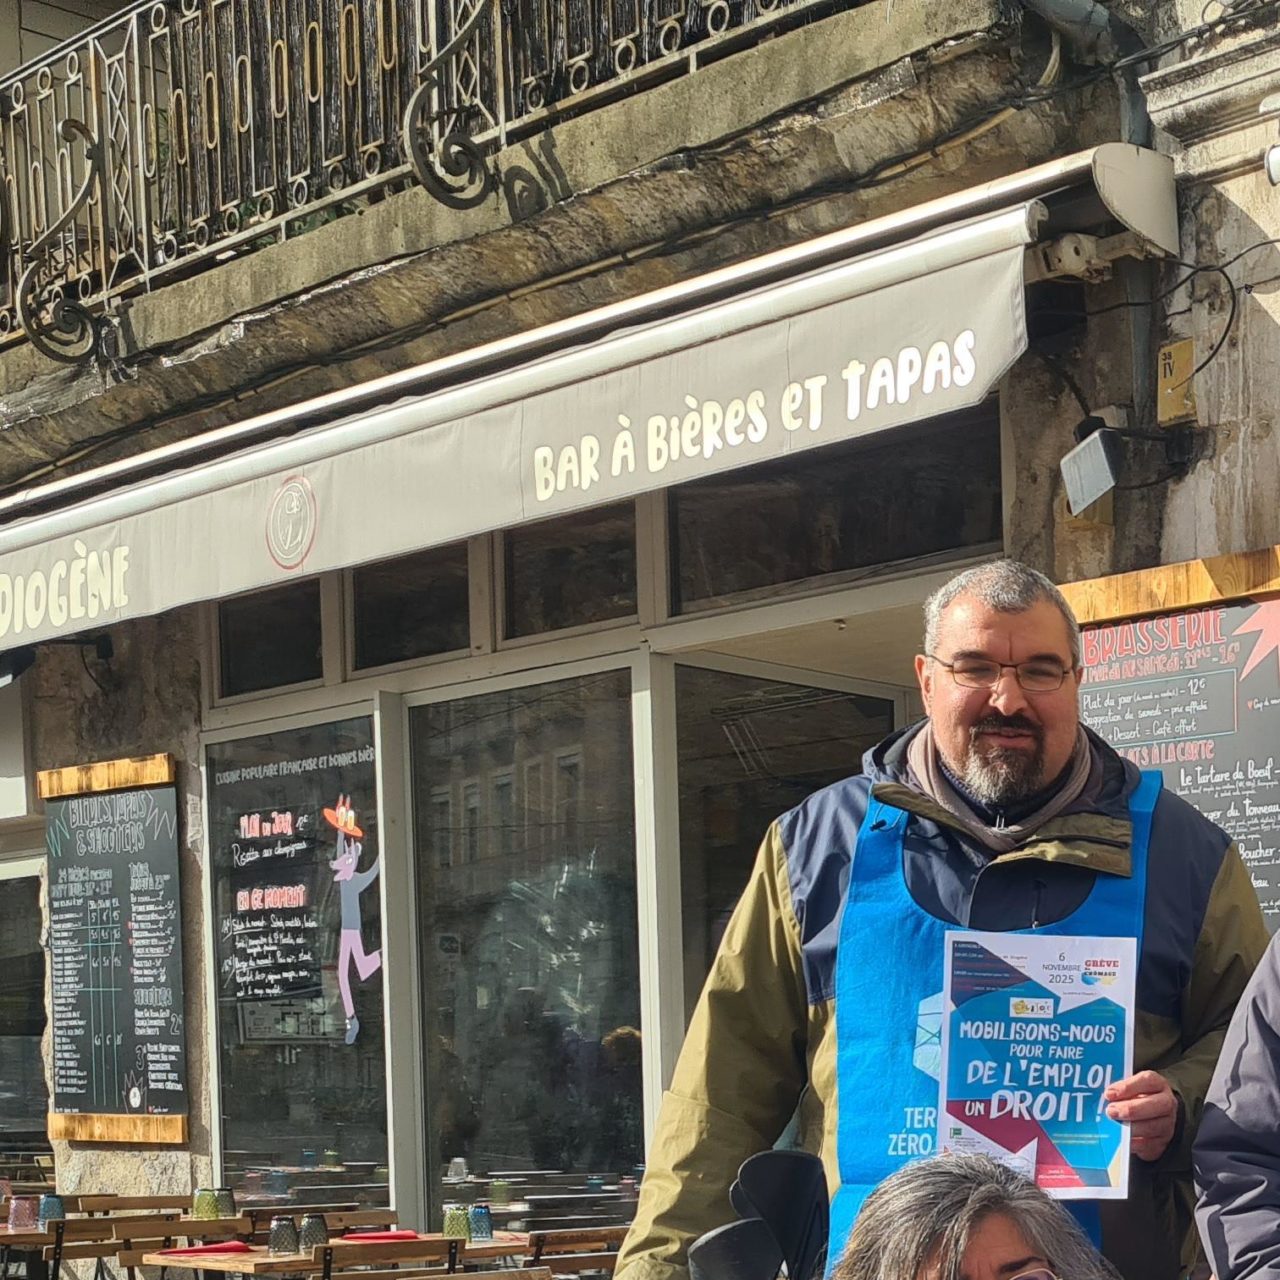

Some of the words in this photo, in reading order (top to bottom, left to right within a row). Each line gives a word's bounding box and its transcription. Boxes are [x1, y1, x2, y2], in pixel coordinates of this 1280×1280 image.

[534, 435, 600, 501] BAR
[611, 414, 635, 476] À
[1082, 607, 1227, 667] BRASSERIE
[1083, 693, 1102, 710] Plat
[1180, 768, 1192, 786] Le
[1195, 764, 1230, 784] Tartare
[1227, 801, 1240, 817] du
[1243, 798, 1280, 817] Tonneau
[1058, 952, 1066, 961] 6
[1048, 974, 1074, 983] 2025
[960, 1021, 1116, 1043] MOBILISONS-NOUS
[1009, 1043, 1042, 1058] POUR
[1048, 1046, 1084, 1059] FAIRE
[967, 1060, 999, 1085] DE
[965, 1101, 985, 1116] UN
[990, 1090, 1093, 1122] DROIT
[887, 1128, 933, 1155] ZÉRO
